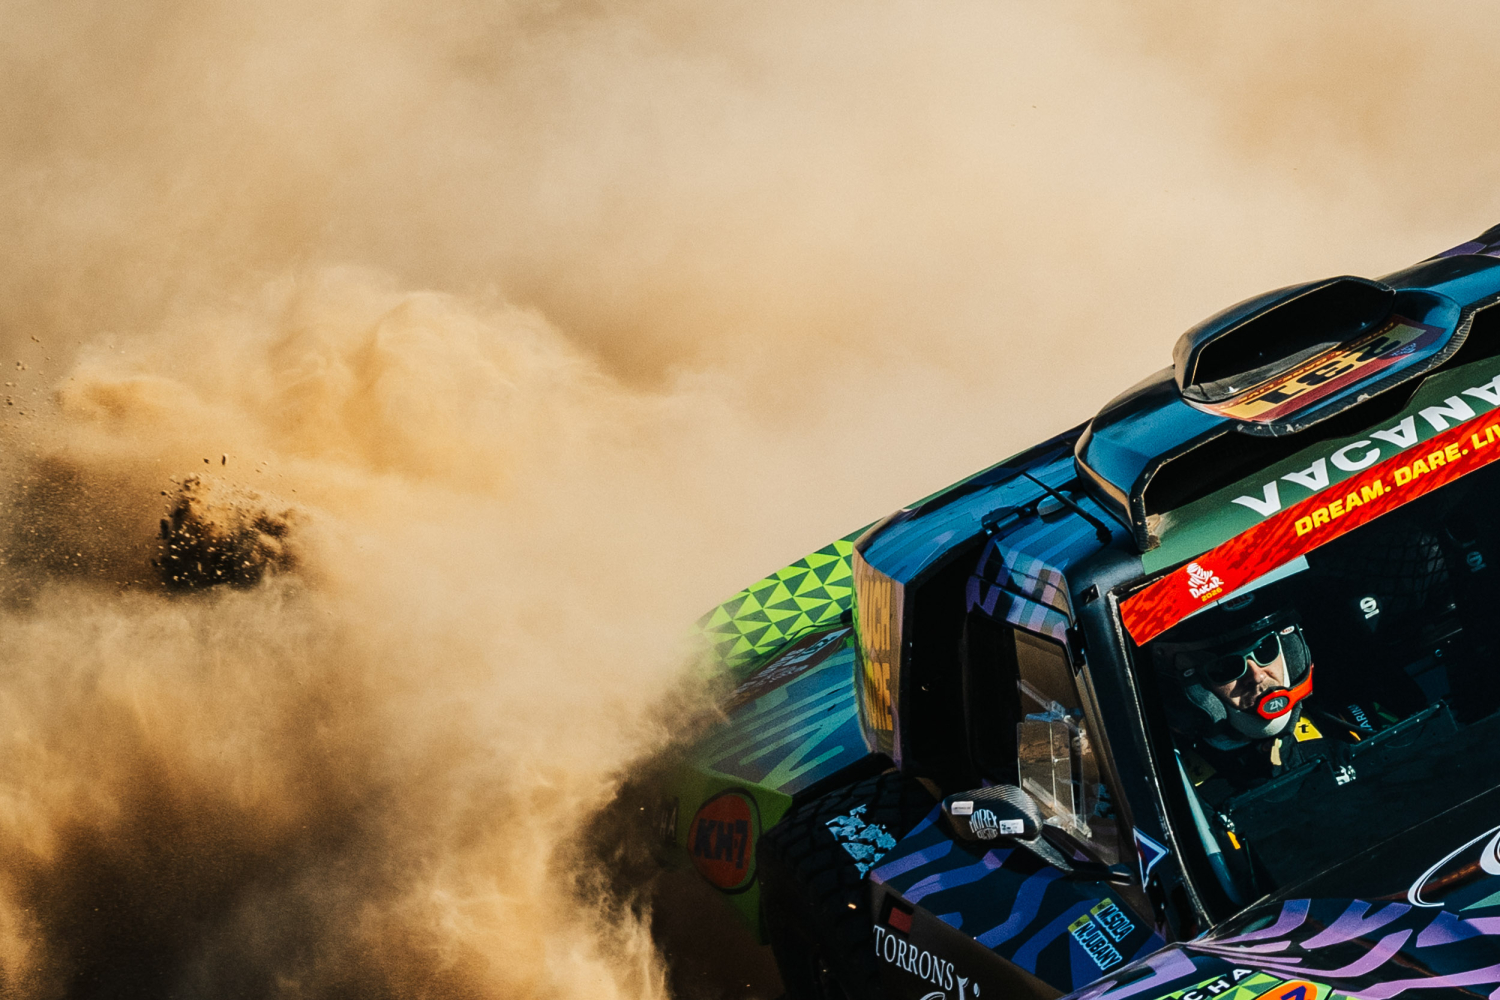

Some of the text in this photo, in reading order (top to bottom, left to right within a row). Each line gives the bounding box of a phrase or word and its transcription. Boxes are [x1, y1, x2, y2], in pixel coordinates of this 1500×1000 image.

[1244, 335, 1402, 406] 231
[1295, 477, 1392, 537] DREAM.
[1394, 442, 1468, 487] DARE.
[1189, 576, 1224, 599] DAKAR
[1201, 587, 1223, 602] 2026
[873, 924, 954, 991] TORRONS
